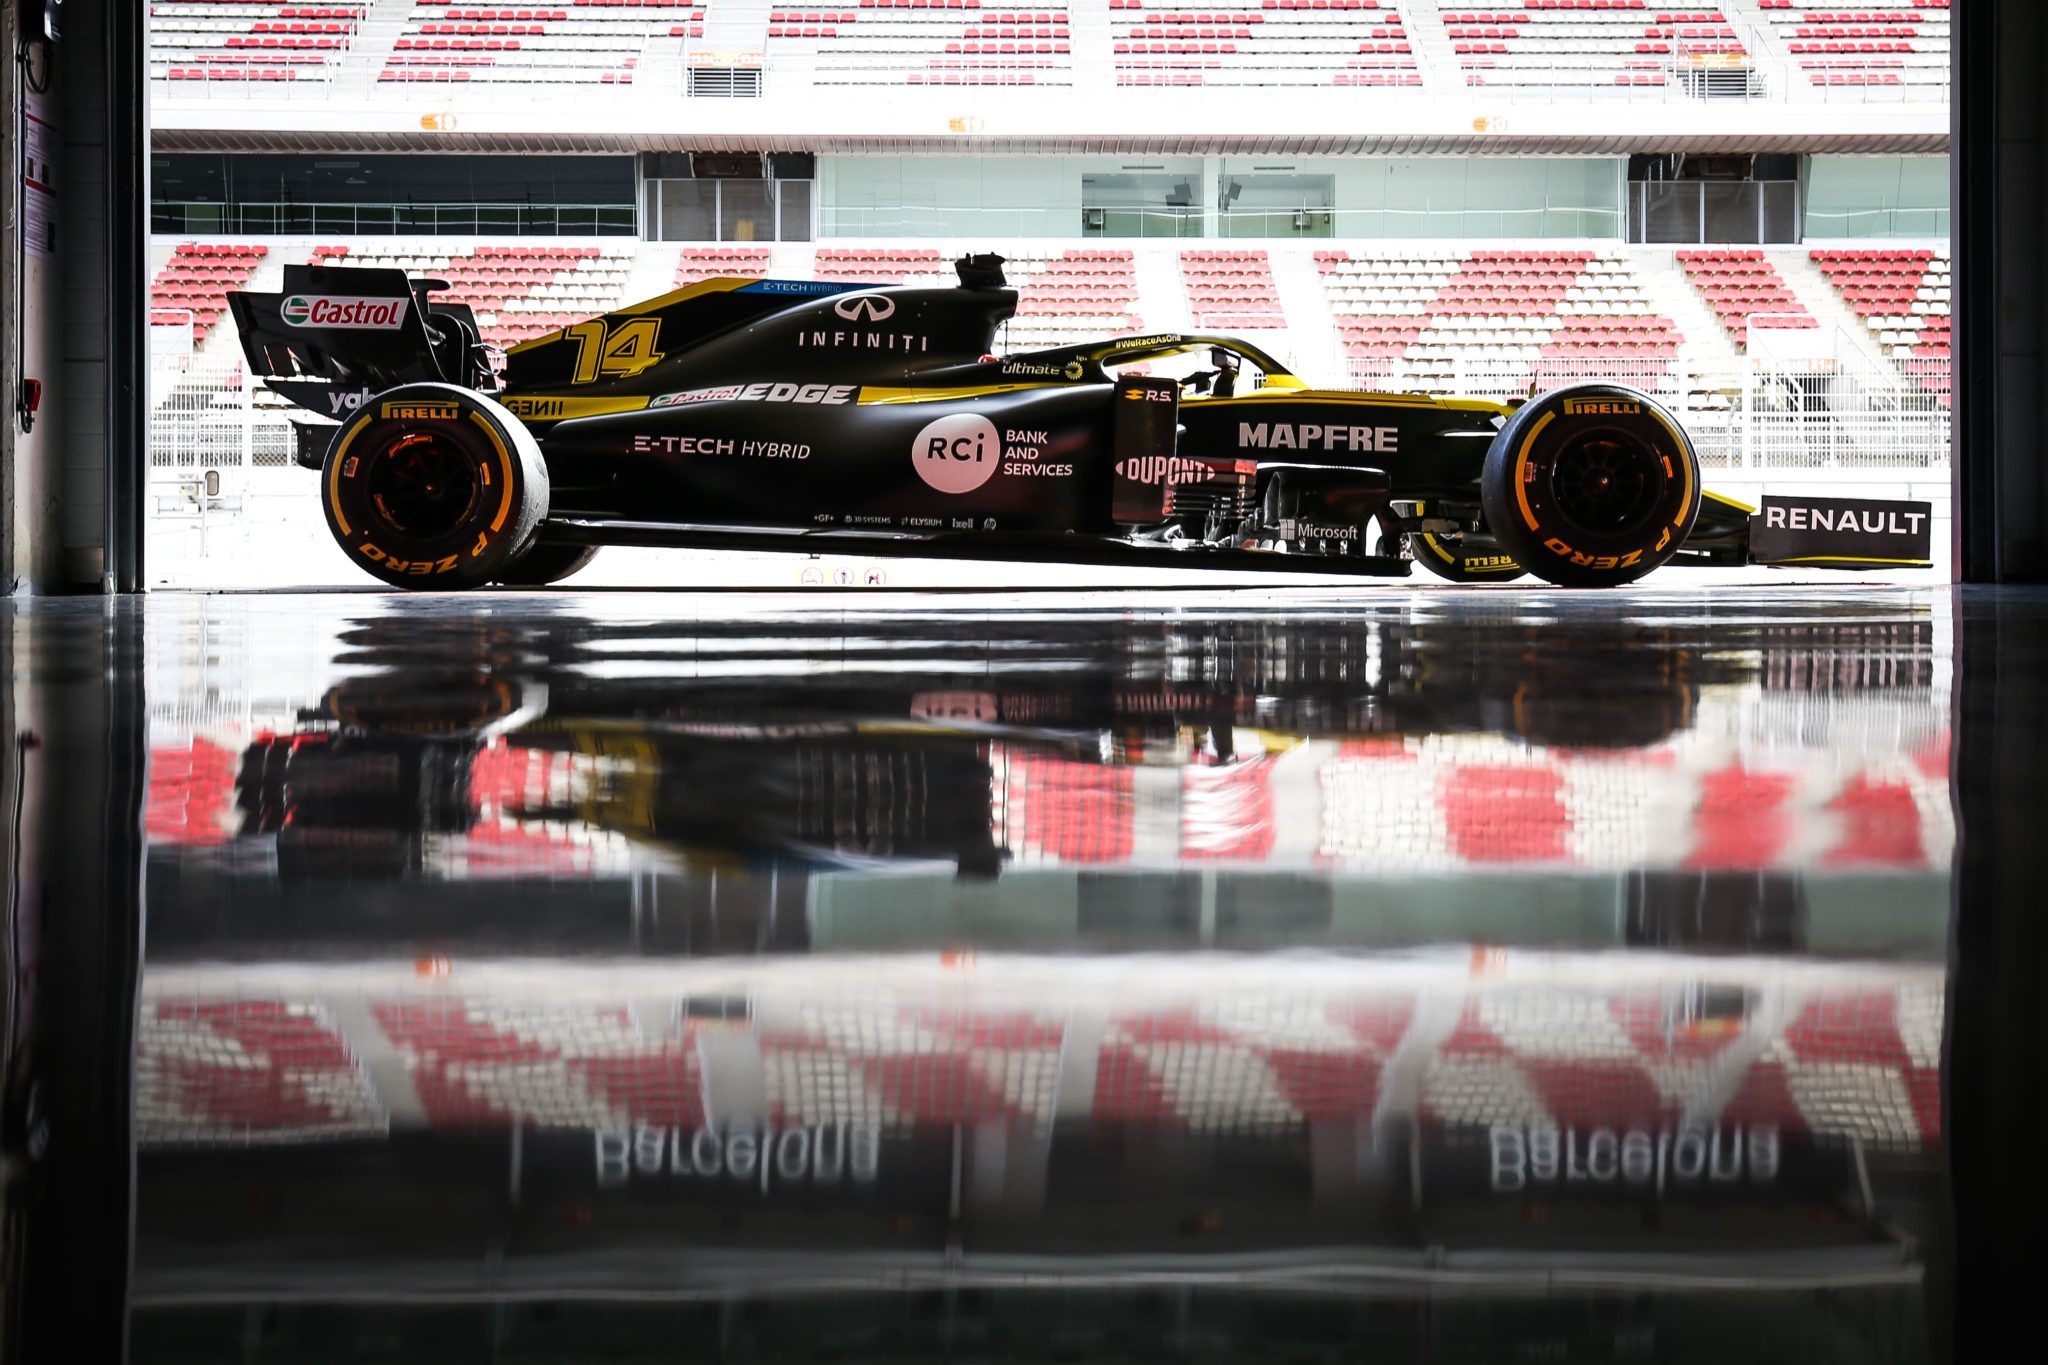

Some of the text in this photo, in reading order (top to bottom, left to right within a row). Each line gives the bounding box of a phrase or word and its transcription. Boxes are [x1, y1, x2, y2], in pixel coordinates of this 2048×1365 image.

[763, 282, 842, 294] E-TECH HYBRID
[310, 298, 400, 325] Castrol
[564, 317, 666, 385] 14
[799, 331, 928, 352] INFINITI
[1115, 334, 1182, 349] #WeRaceAsOne
[1002, 362, 1060, 376] ultimate
[670, 383, 857, 405] Castrol EDGE
[381, 400, 460, 419] PIRELLI
[1563, 397, 1641, 415] PIRELLI
[1006, 429, 1048, 445] BANK
[1238, 422, 1399, 453] MAPFRE
[634, 435, 811, 460] E-TECH HYBRID
[927, 432, 985, 463] RCi
[1004, 446, 1039, 460] AND
[1003, 462, 1073, 477] SERVICES
[1127, 456, 1205, 486] DUPONT
[863, 517, 891, 525] SYSTEMS
[910, 517, 942, 527] ELYSIUM
[1766, 506, 1926, 535] RENAULT
[1298, 523, 1358, 540] Microsoft
[358, 530, 487, 575] P ZERO
[1543, 526, 1671, 570] P ZERO
